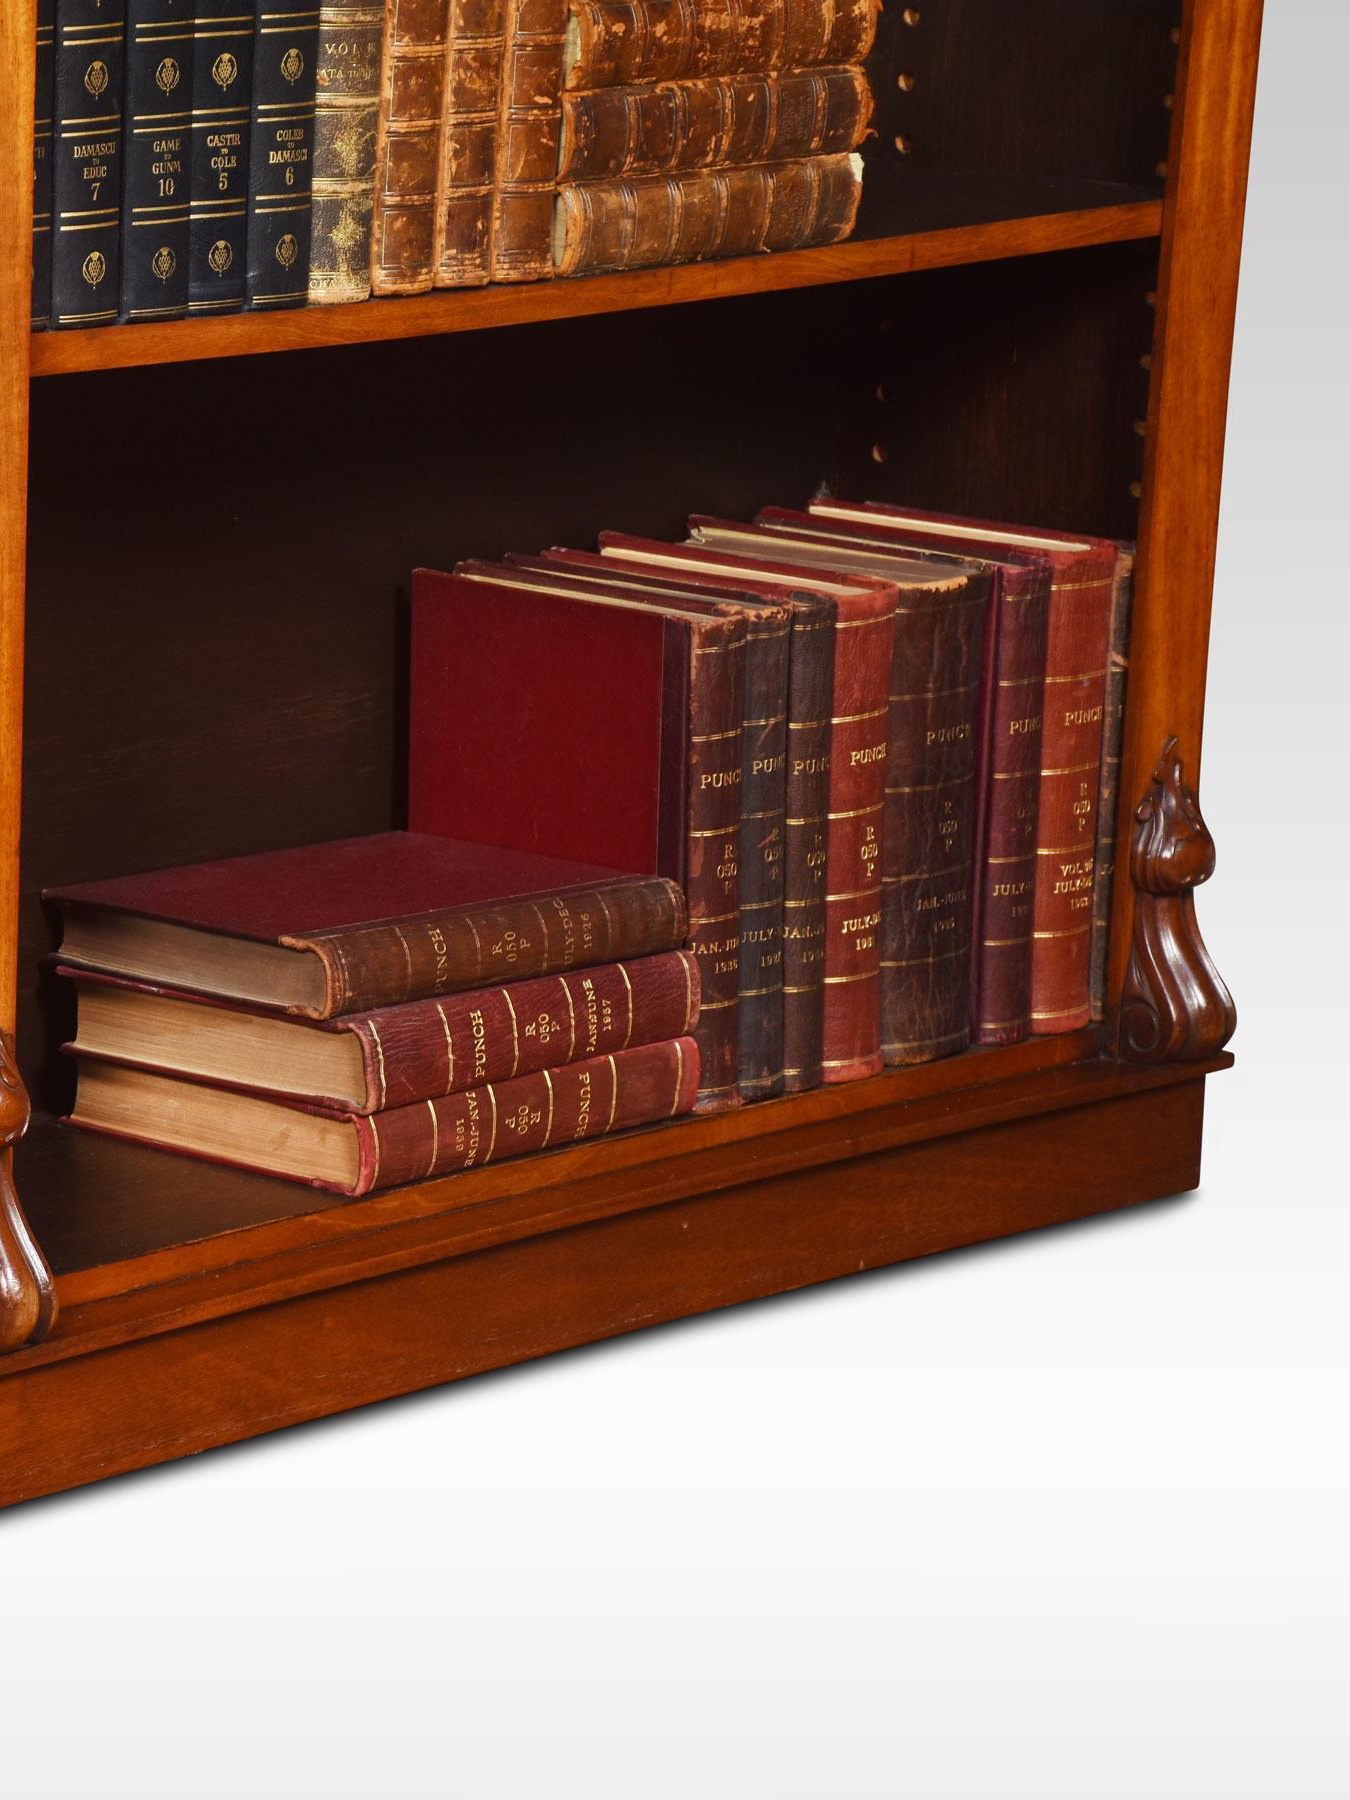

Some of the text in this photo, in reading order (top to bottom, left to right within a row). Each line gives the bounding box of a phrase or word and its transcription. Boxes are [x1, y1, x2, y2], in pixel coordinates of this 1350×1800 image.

[74, 141, 117, 158] DAMASCU
[153, 138, 182, 152] GAME
[152, 160, 181, 175] GUNM
[210, 155, 237, 168] COLE
[83, 166, 107, 179] EDUC
[218, 172, 229, 190] 5
[285, 166, 294, 186] 6
[91, 182, 101, 201] 7
[158, 177, 175, 197] 10
[850, 742, 887, 766] PUNCH
[724, 844, 734, 859] R
[861, 843, 878, 860] 050
[866, 862, 875, 877] P
[553, 896, 574, 965] ULY-DEC
[492, 943, 503, 955] R
[505, 931, 517, 962] 050
[519, 938, 531, 950] P
[525, 1022, 536, 1037] R
[538, 1013, 550, 1043] 050
[551, 1021, 560, 1032] P
[469, 1009, 486, 1078] PUNCH
[574, 1071, 591, 1138] PUNCH
[505, 1116, 516, 1129] P
[517, 1105, 529, 1135] 050
[530, 1111, 541, 1126] R
